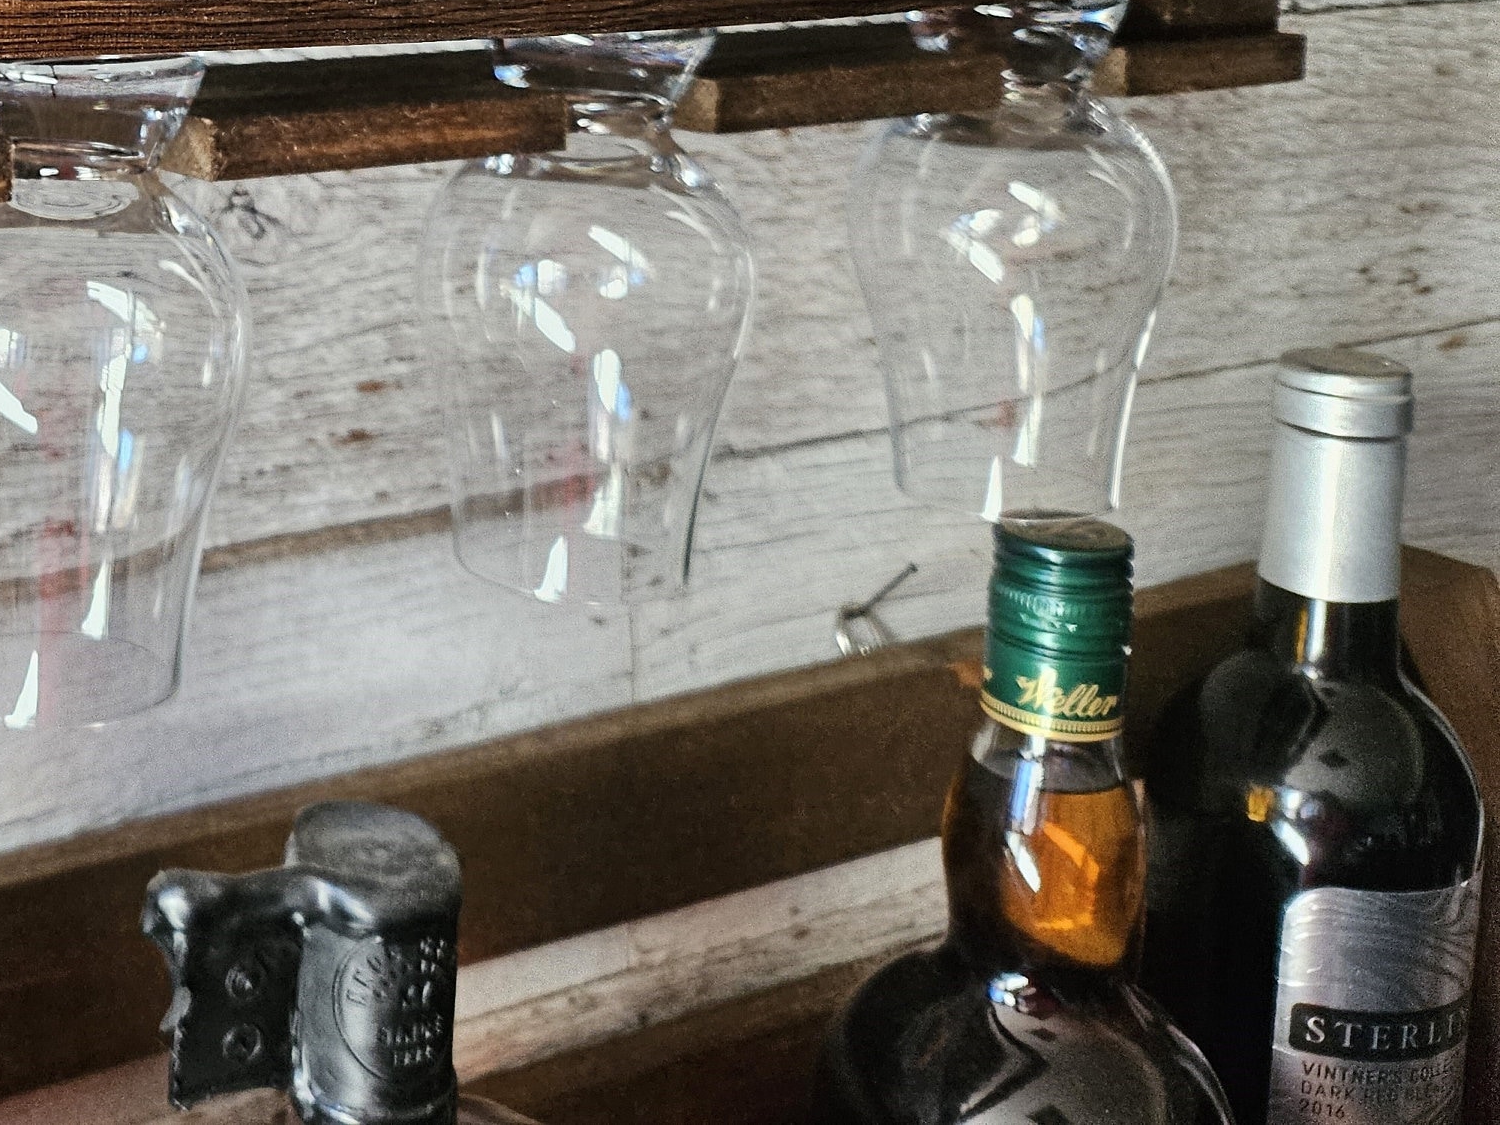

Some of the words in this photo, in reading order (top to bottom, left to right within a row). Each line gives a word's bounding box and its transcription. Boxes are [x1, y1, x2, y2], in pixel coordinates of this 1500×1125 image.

[1016, 665, 1118, 718] Weller
[1300, 1079, 1356, 1101] DARK
[1298, 1098, 1346, 1120] 2016
